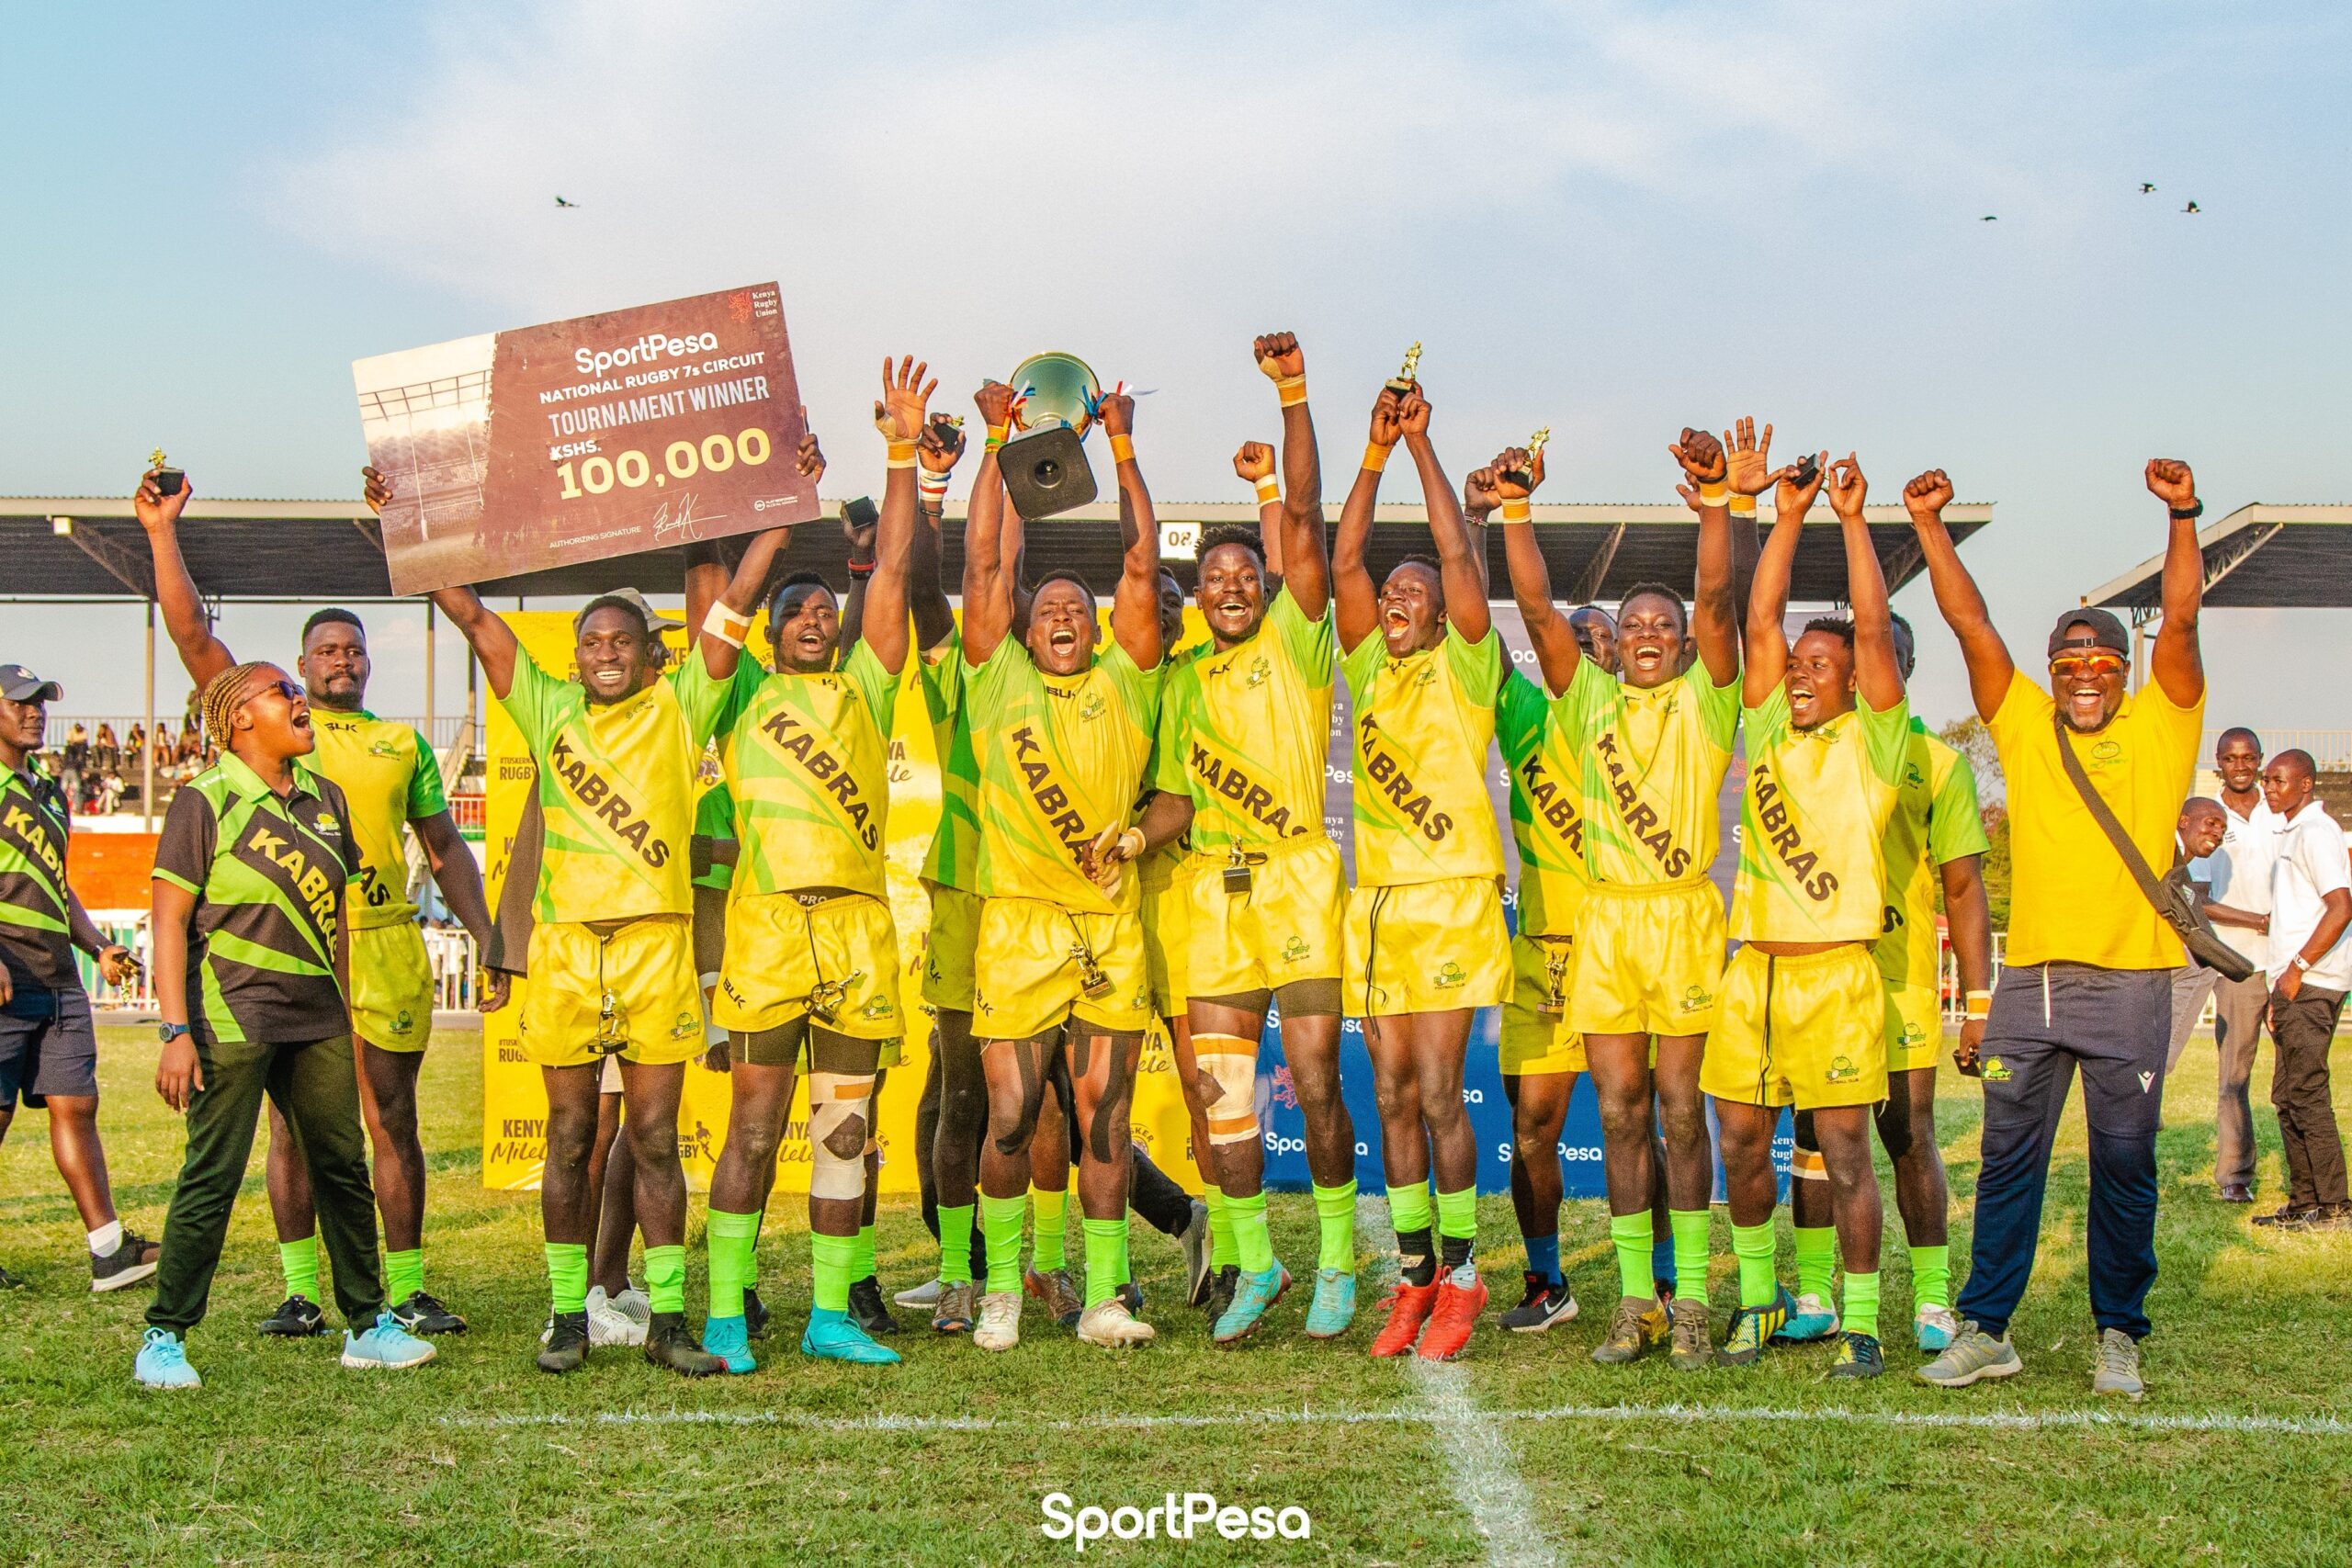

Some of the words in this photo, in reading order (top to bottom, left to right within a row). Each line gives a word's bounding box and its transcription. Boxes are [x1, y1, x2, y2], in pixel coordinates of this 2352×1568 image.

[752, 290, 775, 299] Kenya
[753, 299, 778, 309] Rugby
[755, 309, 777, 318] Union
[539, 379, 623, 404] NATIONAL
[625, 367, 680, 387] RUGBY
[683, 365, 700, 378] 7s
[703, 352, 765, 374] CIRCUIT
[575, 332, 719, 378] SportPesa
[548, 390, 685, 437] TOURNAMENT
[688, 375, 770, 412] WINNER
[549, 439, 603, 460] KSHS.
[556, 427, 771, 501] 100,000
[549, 534, 599, 549] AUTHORIZING
[600, 525, 641, 542] SIGNATURE
[553, 734, 671, 870] KABRAS
[762, 711, 879, 852] KABRAS
[1361, 713, 1453, 843] KABRAS
[1598, 733, 1690, 878] KABRAS
[1754, 764, 1839, 903] KABRAS
[723, 976, 746, 1010] BLK
